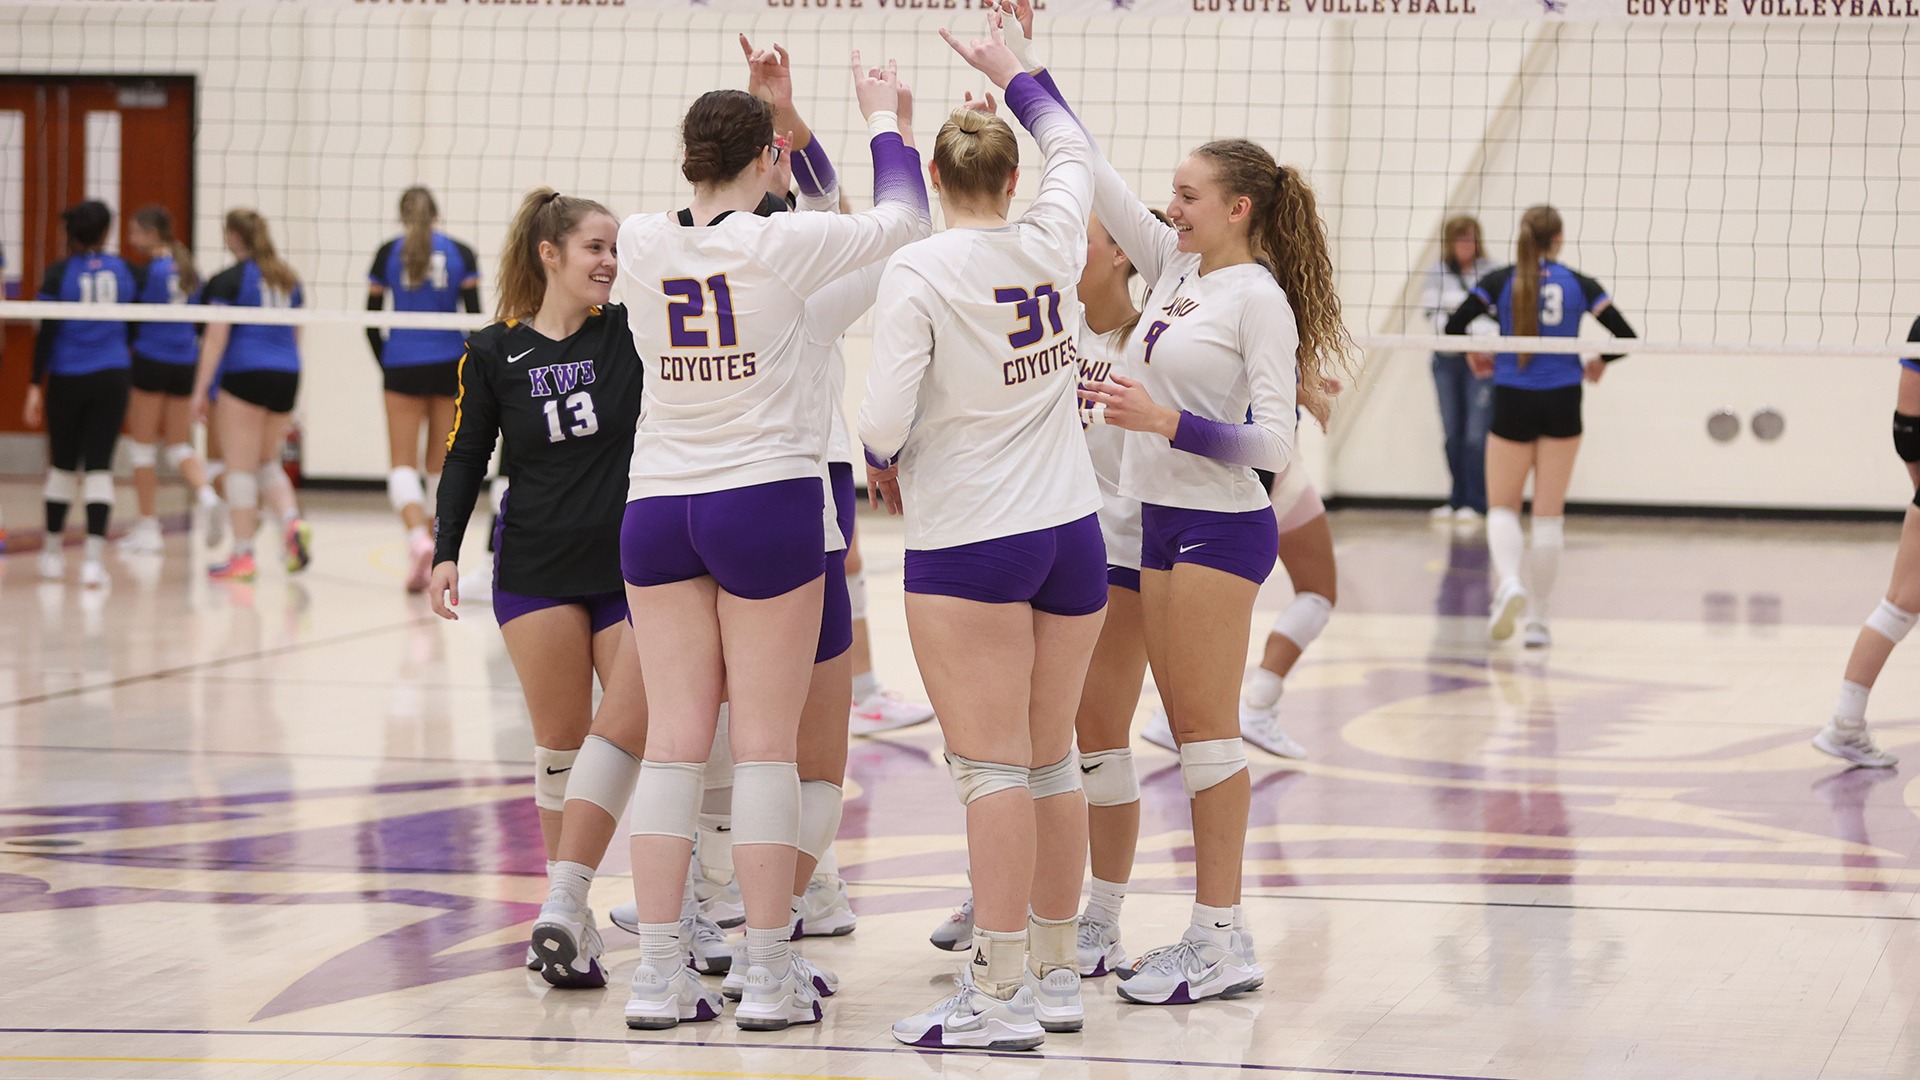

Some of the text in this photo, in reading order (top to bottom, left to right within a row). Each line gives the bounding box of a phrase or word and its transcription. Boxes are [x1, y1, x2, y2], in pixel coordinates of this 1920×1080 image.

[1305, 0, 1476, 14] VOLLEYBALL
[1627, 0, 1919, 17] COYOTE VOLLEYBALL
[661, 272, 738, 348] 21
[992, 282, 1064, 350] 31
[1002, 335, 1077, 386] COYOTES
[1142, 319, 1171, 366] 9
[660, 352, 757, 382] COYOTES
[1076, 357, 1112, 383] WU
[543, 390, 599, 443] 13
